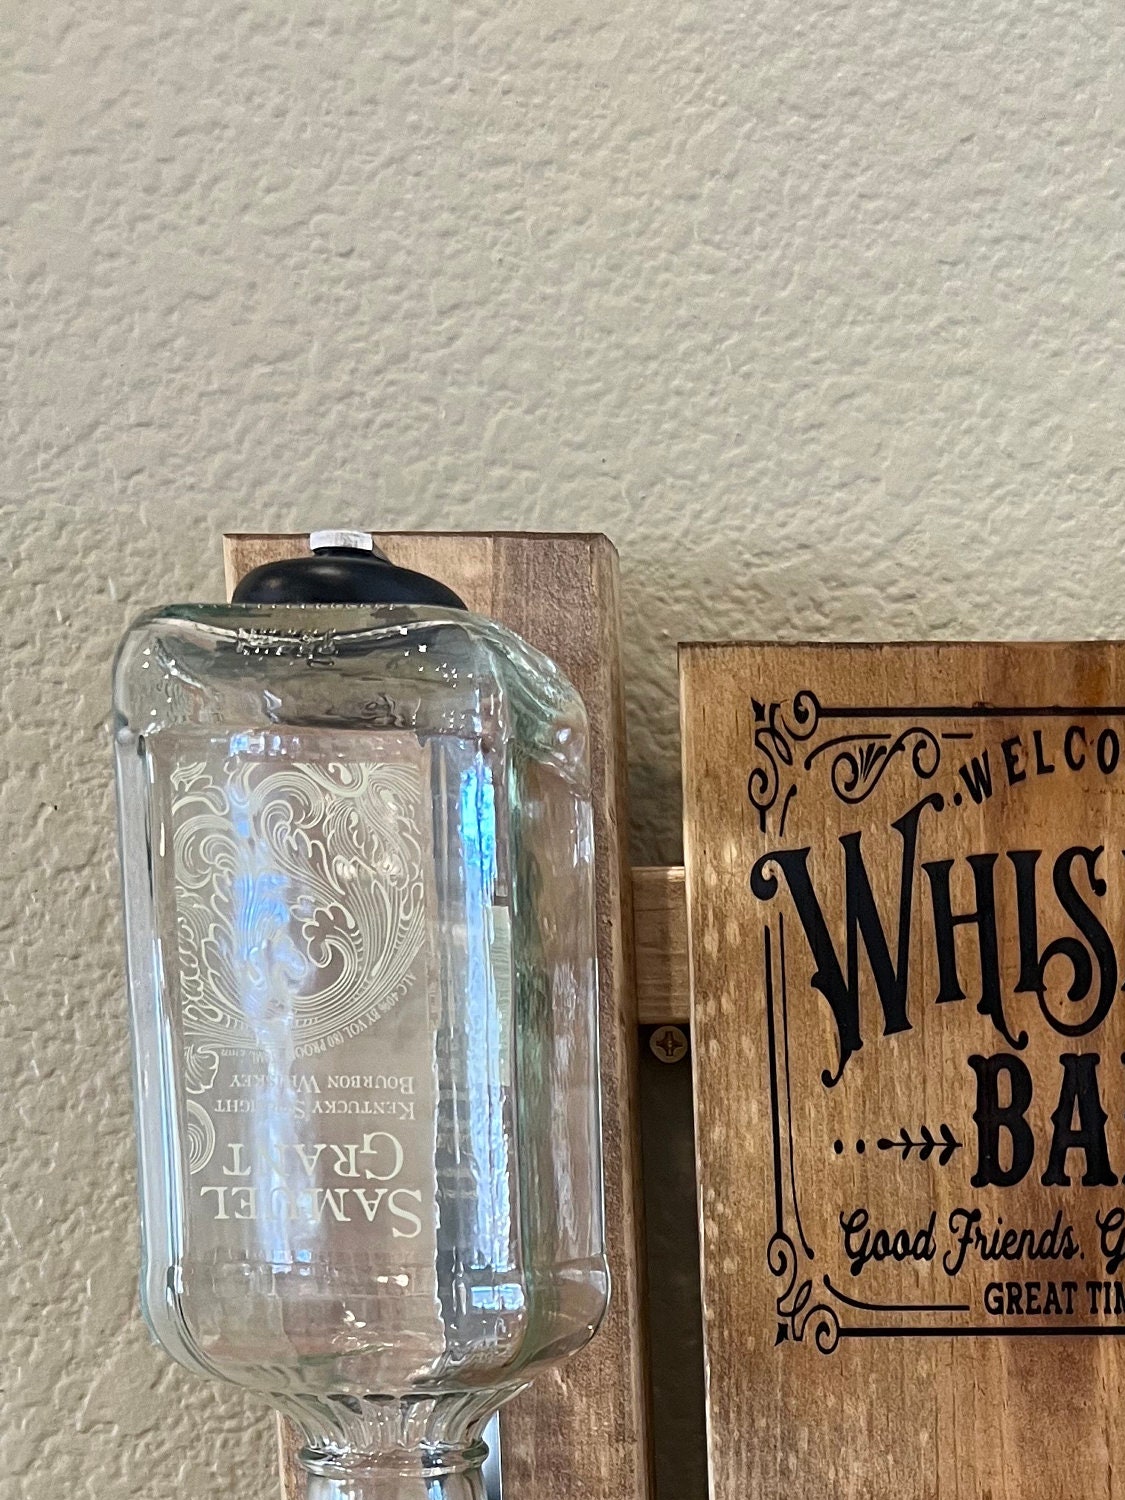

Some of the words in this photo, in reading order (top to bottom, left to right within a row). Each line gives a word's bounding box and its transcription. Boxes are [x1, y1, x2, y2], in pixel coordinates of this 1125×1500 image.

[365, 1009, 381, 1024] BY
[343, 1019, 367, 1037] VOL
[328, 1074, 414, 1094] BOURBON
[214, 1100, 306, 1118] SIGHT
[312, 1100, 415, 1120] KENTUCKY
[223, 1131, 404, 1180] GRANT
[200, 1186, 422, 1238] SAMUEL
[839, 1208, 937, 1276] Good
[984, 1280, 1079, 1316] GREAT
